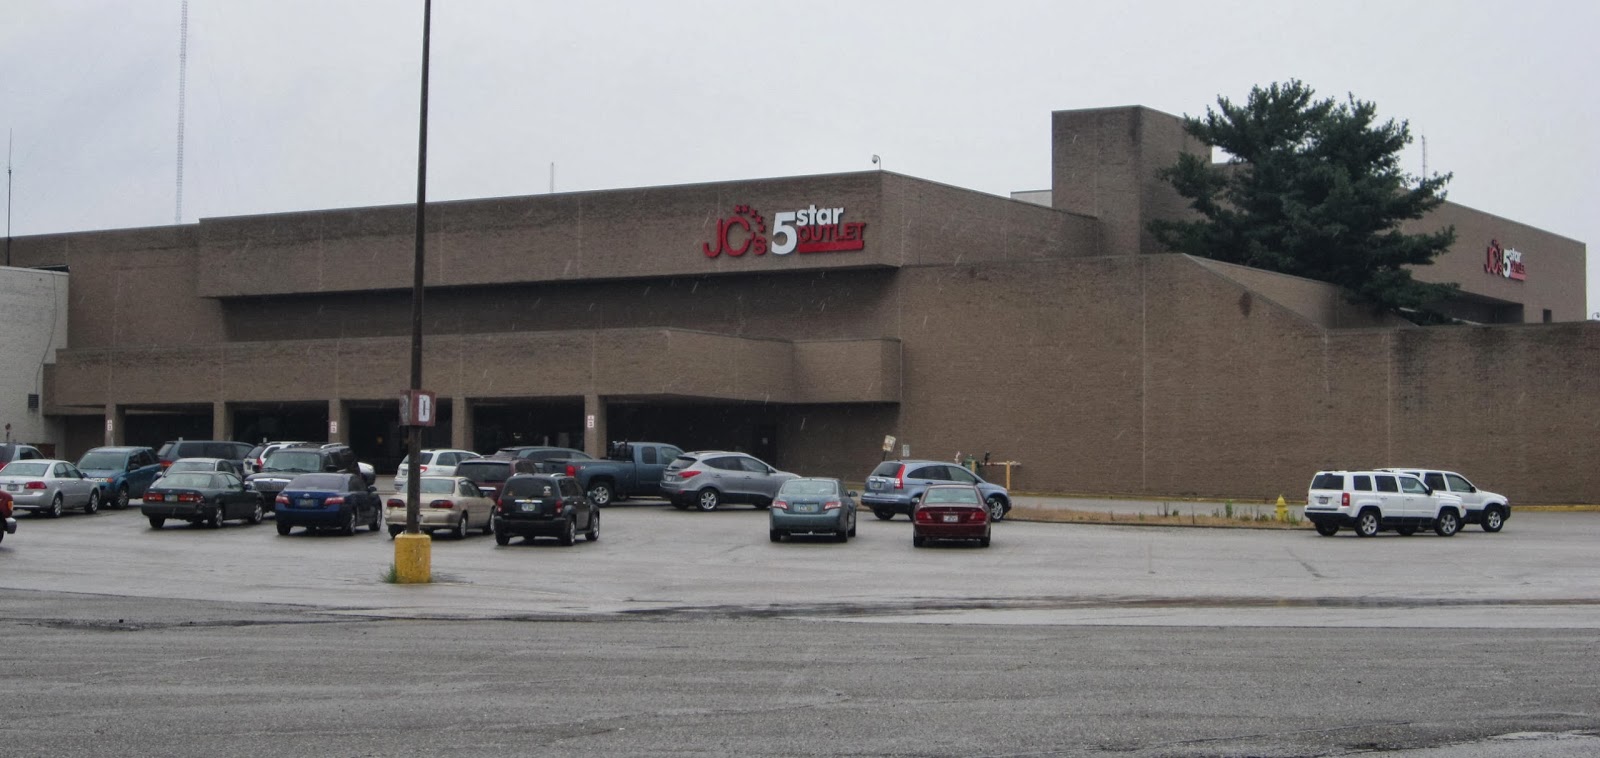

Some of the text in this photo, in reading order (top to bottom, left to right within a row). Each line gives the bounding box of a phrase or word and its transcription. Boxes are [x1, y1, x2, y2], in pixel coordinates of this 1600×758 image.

[703, 204, 844, 258] JC's 5 star
[797, 222, 866, 243] OUTLET
[1503, 248, 1511, 278] 5
